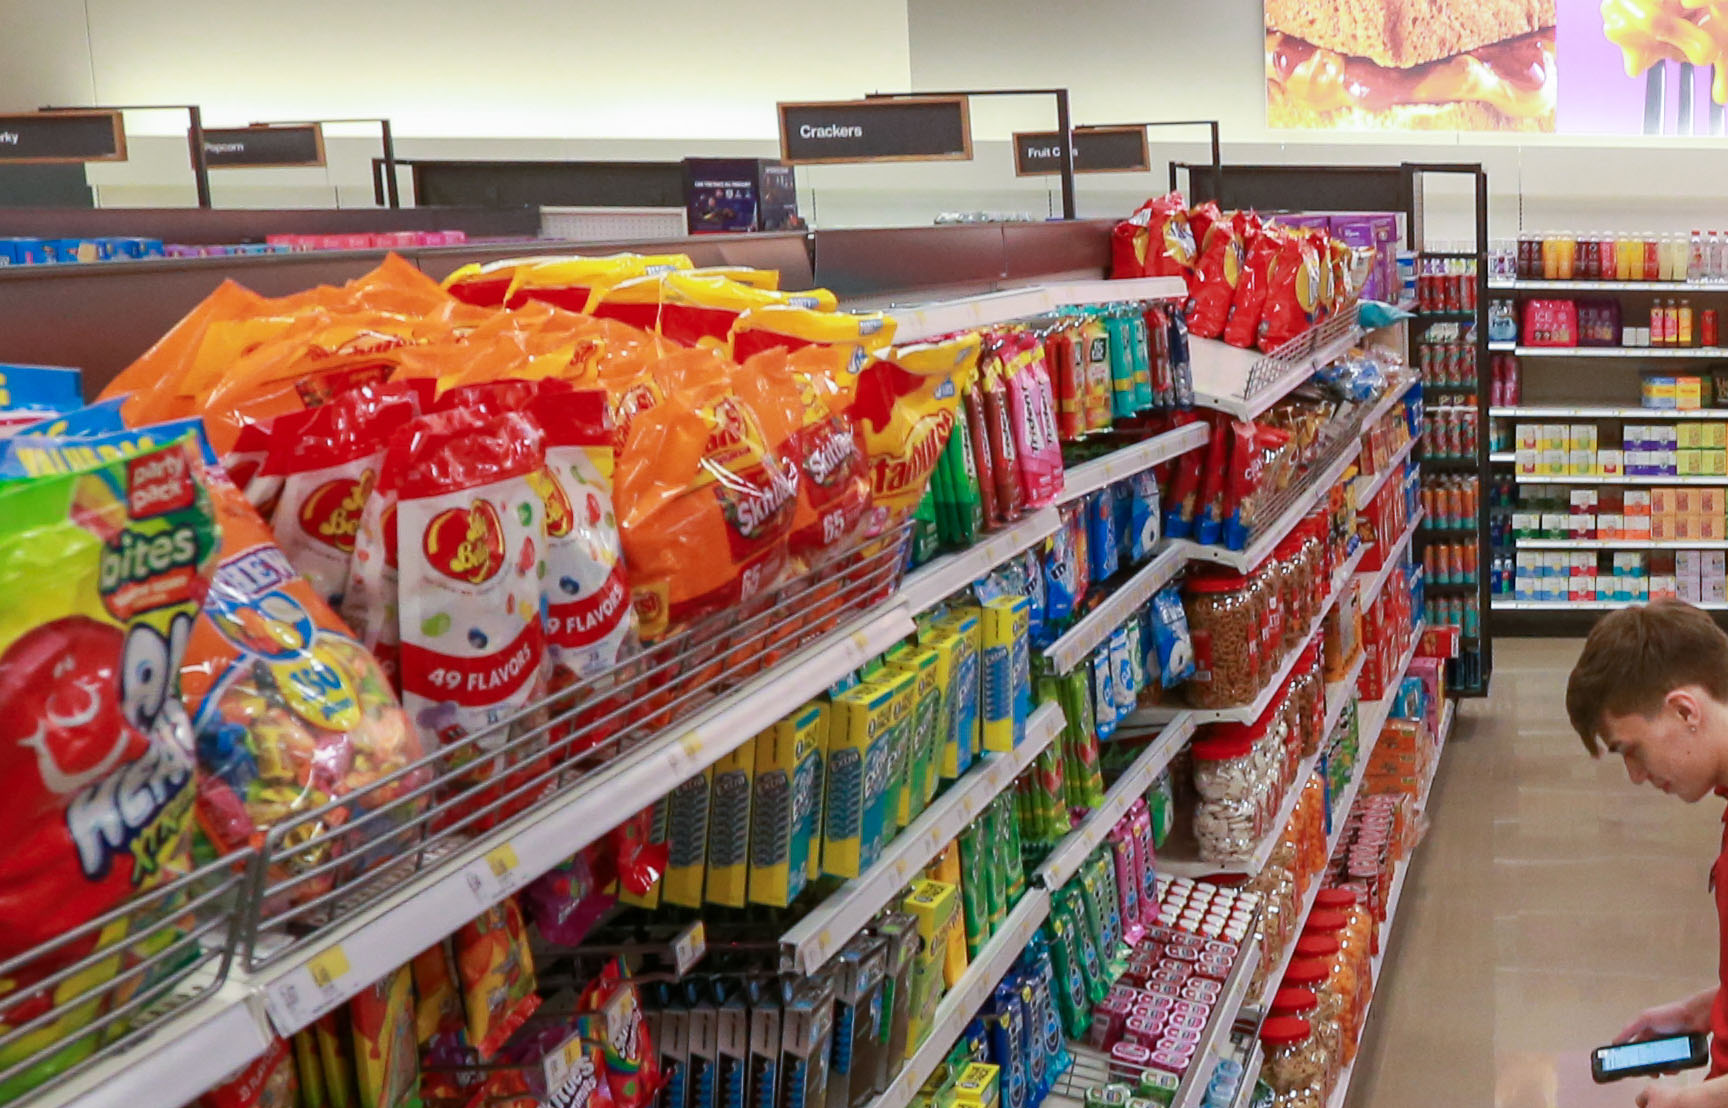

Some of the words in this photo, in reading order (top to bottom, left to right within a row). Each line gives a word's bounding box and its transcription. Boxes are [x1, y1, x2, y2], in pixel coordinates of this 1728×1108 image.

[0, 132, 19, 146] rky
[800, 123, 863, 140] Crackers
[1028, 147, 1051, 159] Fruit
[133, 456, 182, 487] party
[132, 480, 183, 512] pack
[101, 525, 196, 593] bites
[565, 582, 624, 634] FLAVORS
[428, 668, 461, 688] 49
[467, 644, 532, 691] FLAVORS
